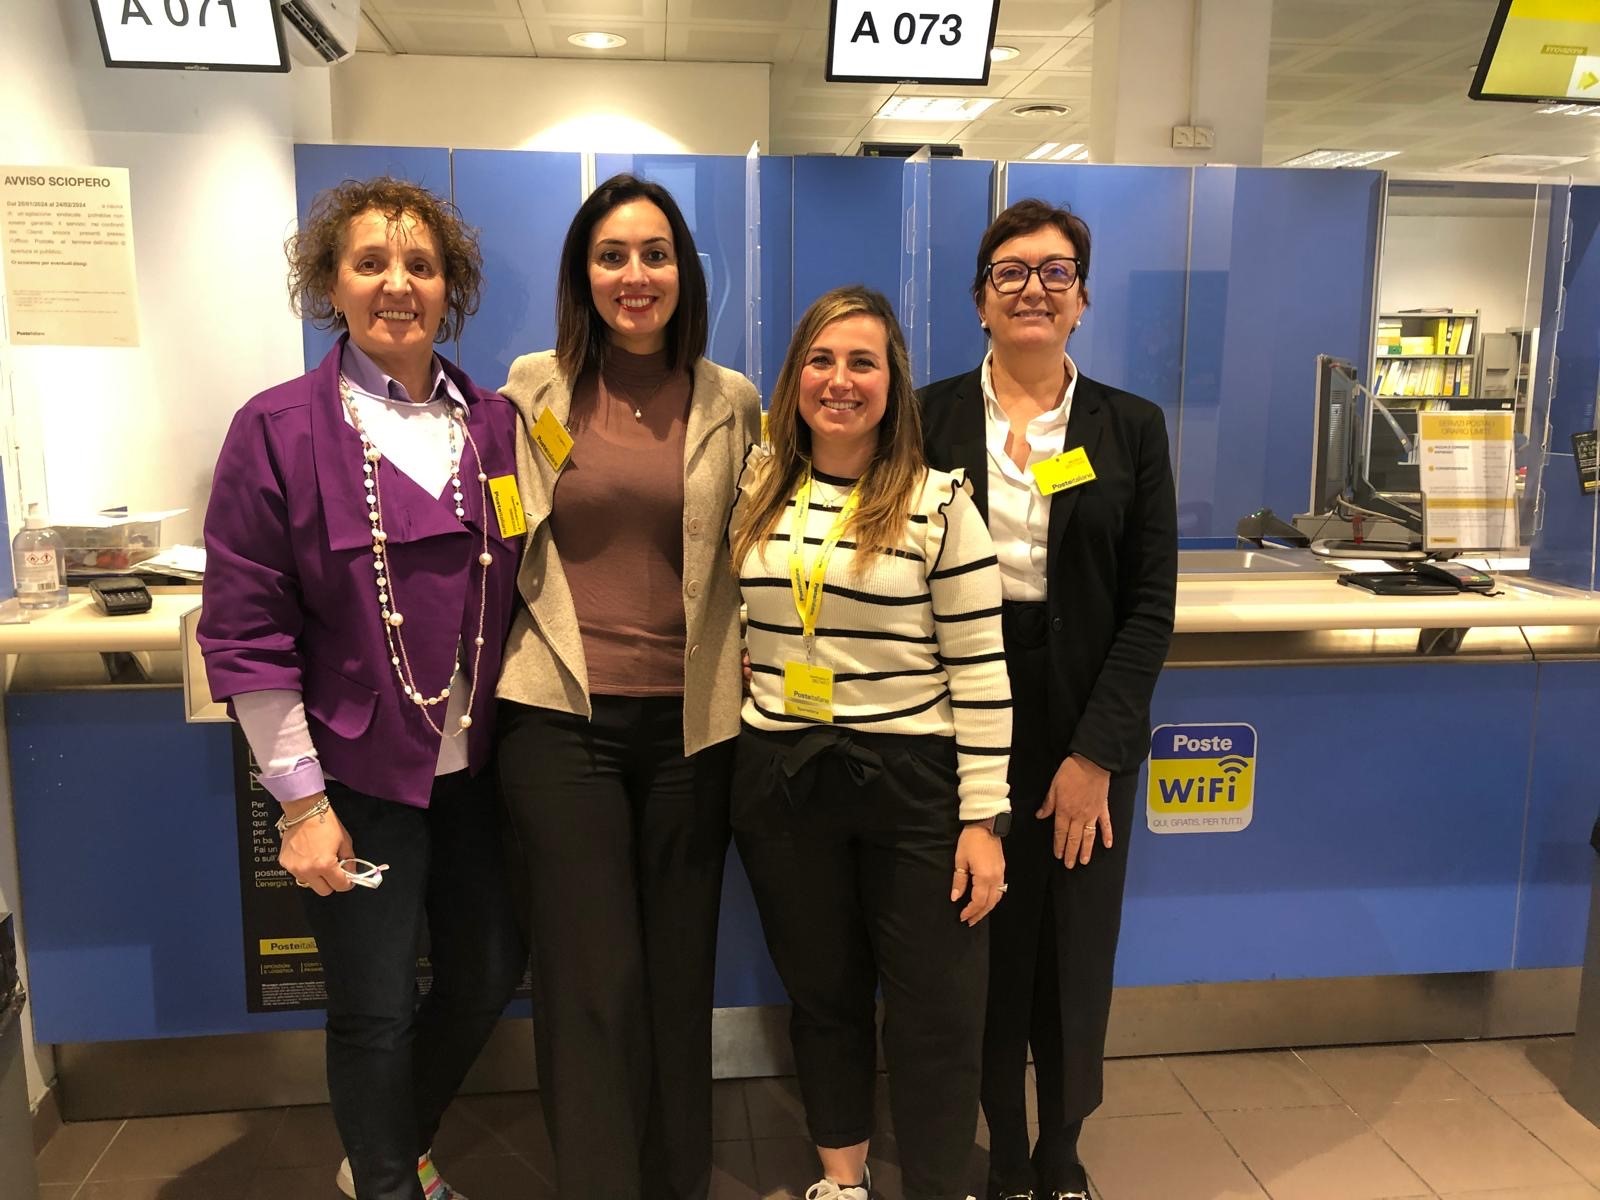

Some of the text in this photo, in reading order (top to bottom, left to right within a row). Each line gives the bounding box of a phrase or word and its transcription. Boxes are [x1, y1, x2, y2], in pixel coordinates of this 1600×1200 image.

[121, 0, 237, 28] A 071
[850, 11, 962, 46] A 073
[4, 176, 111, 188] AVVISO SCIOPERO
[1173, 734, 1233, 752] Poste
[1159, 776, 1236, 804] WiFi
[251, 801, 265, 809] Per
[251, 810, 269, 818] Con
[1202, 818, 1219, 826] PER
[253, 837, 261, 845] in
